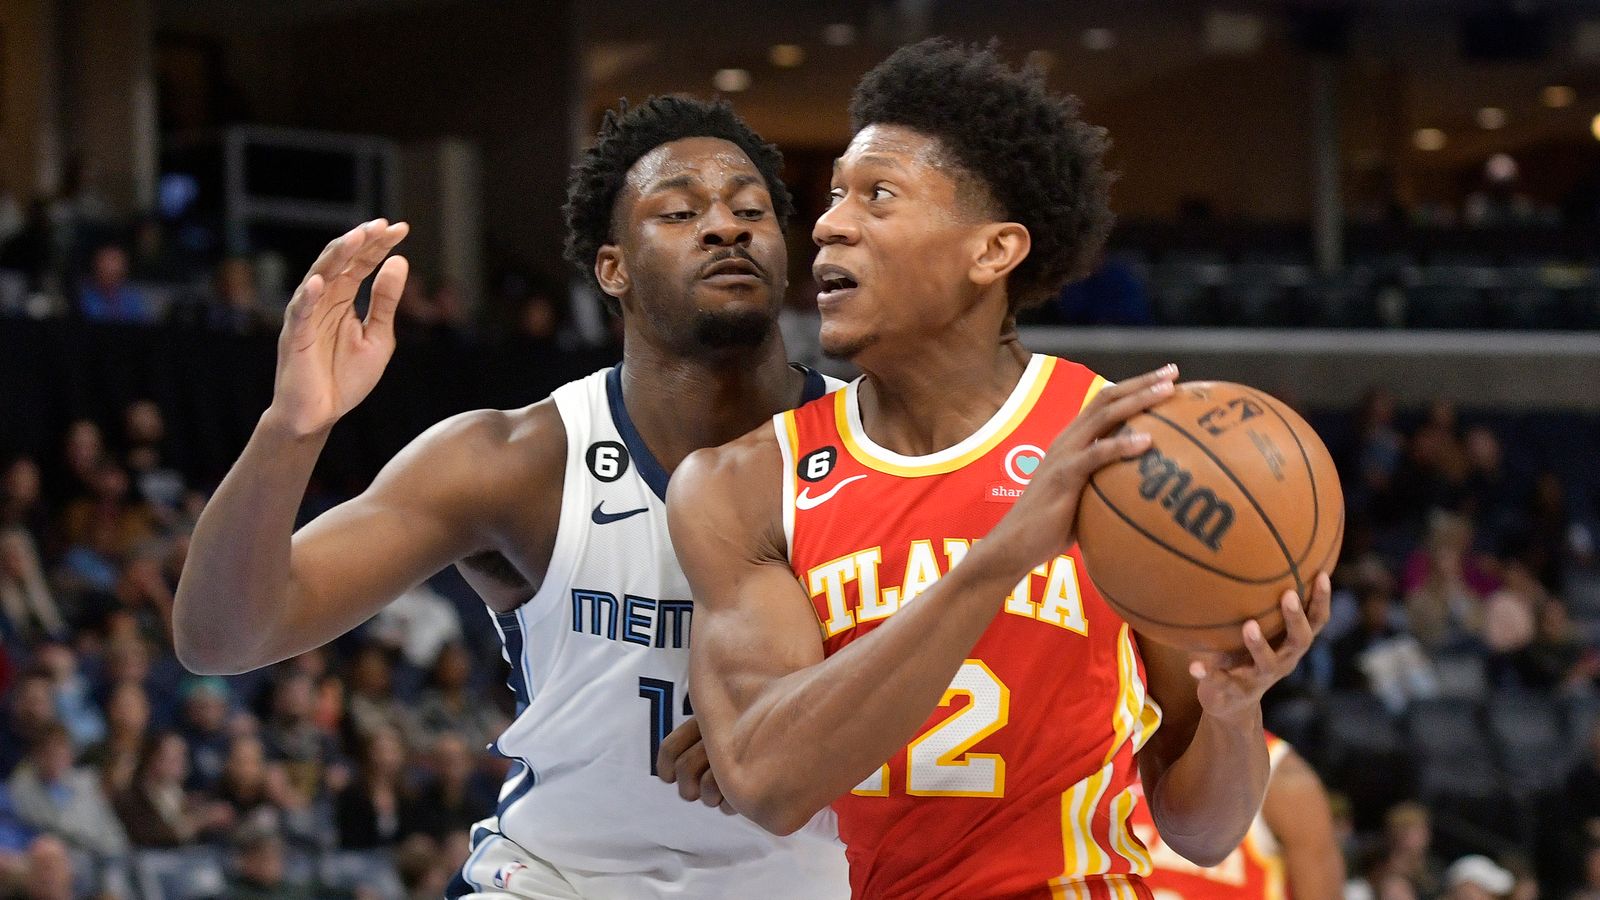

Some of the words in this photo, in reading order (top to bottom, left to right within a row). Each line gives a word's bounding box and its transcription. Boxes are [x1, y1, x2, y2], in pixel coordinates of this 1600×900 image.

[594, 446, 620, 478] 6
[807, 451, 831, 479] 6
[991, 485, 1025, 497] shar
[1137, 447, 1237, 553] Wils
[571, 588, 694, 649] MEM
[800, 538, 1089, 638] TLATA
[639, 676, 694, 776] 1
[850, 658, 1011, 798] 2
